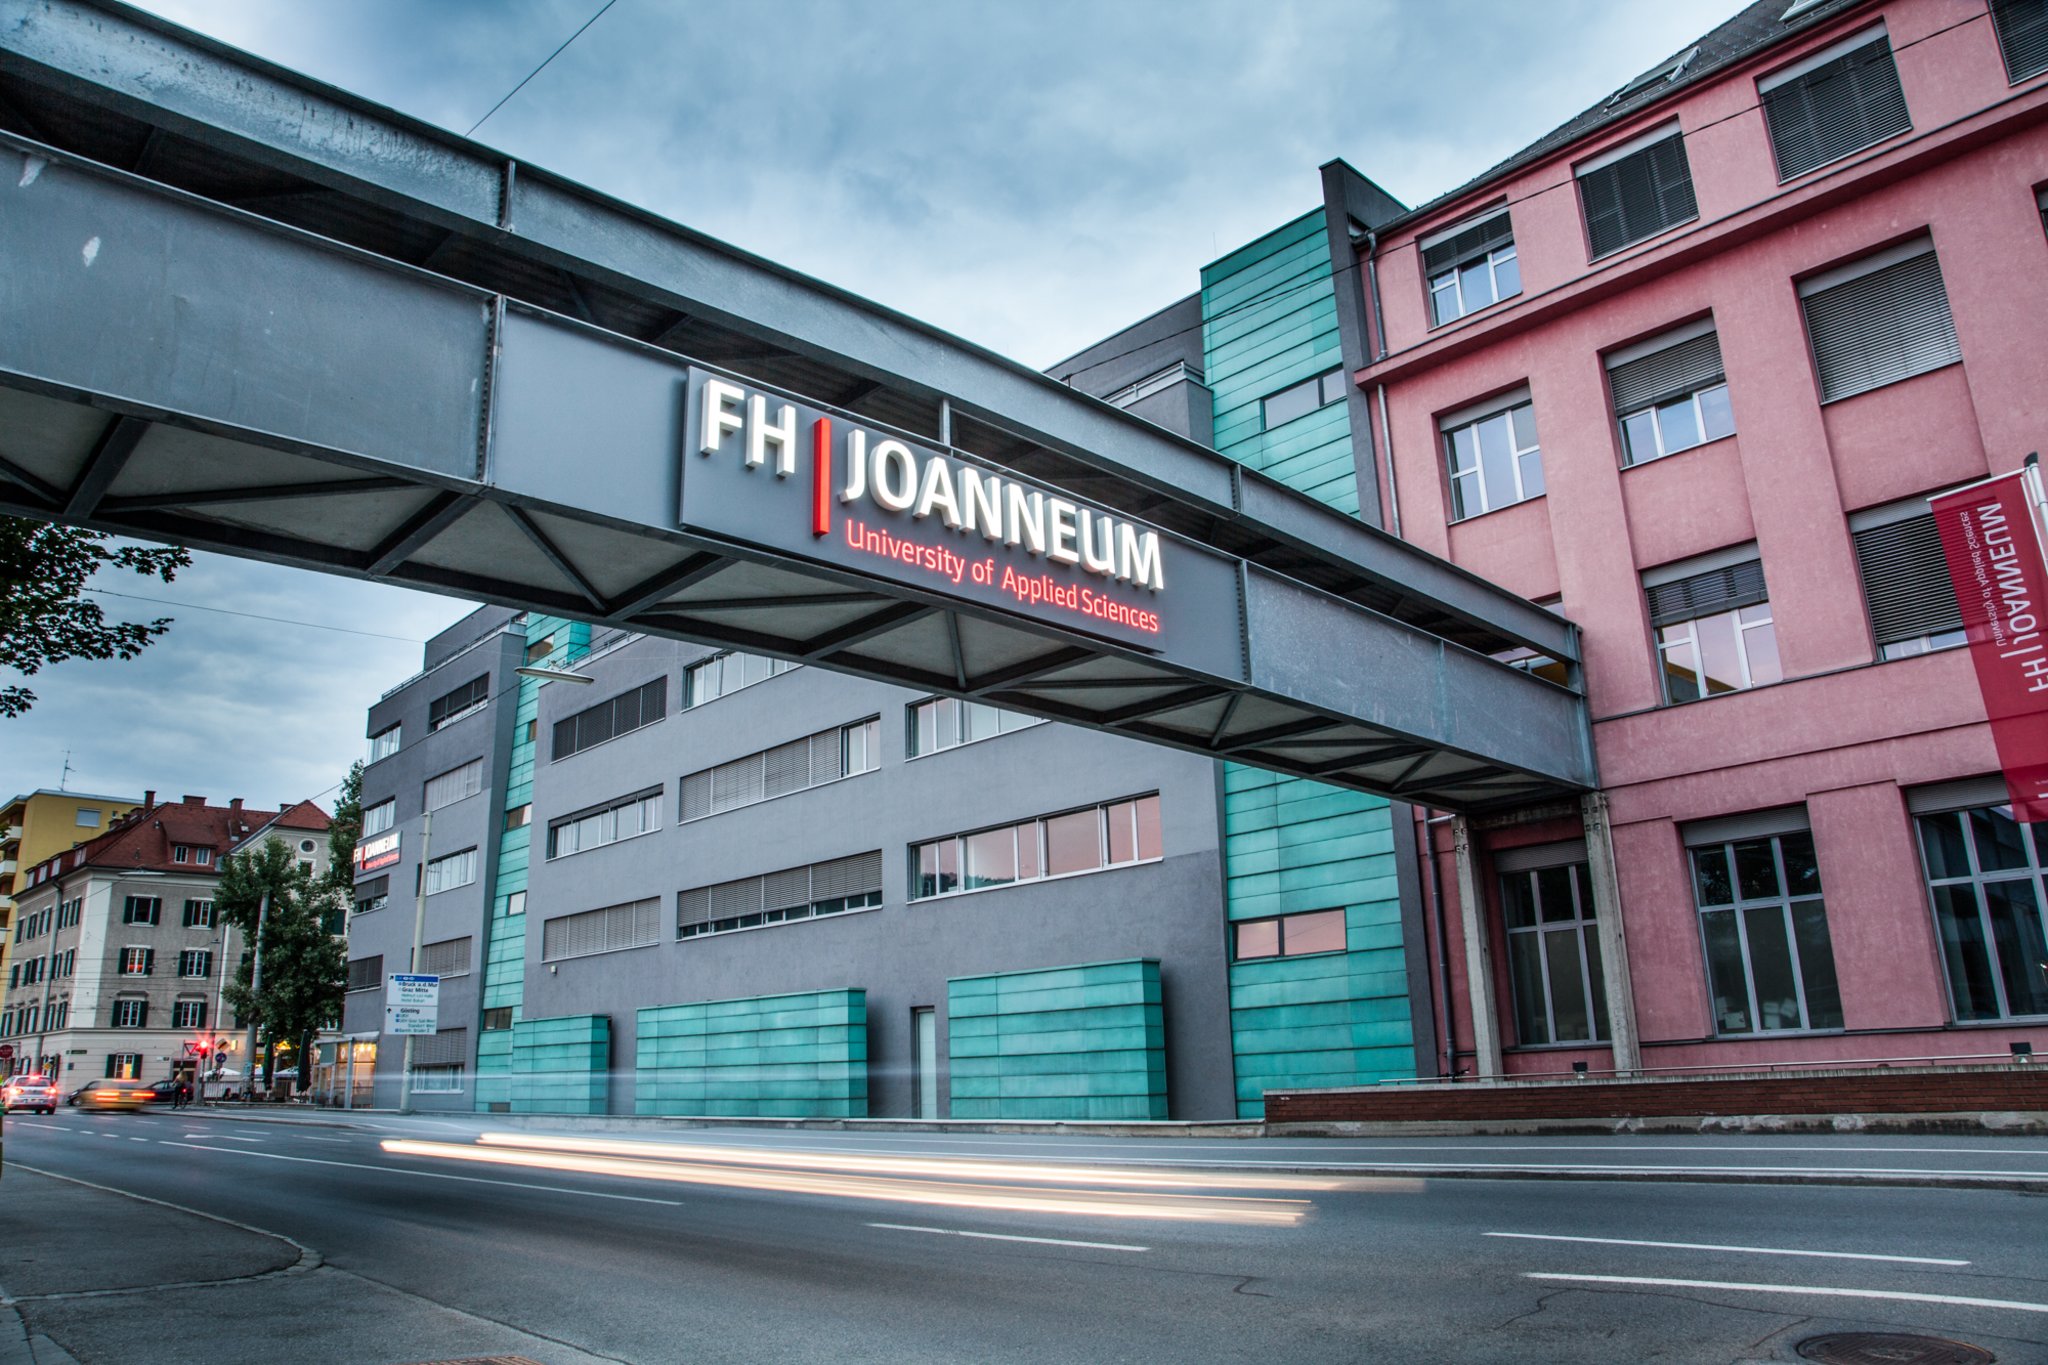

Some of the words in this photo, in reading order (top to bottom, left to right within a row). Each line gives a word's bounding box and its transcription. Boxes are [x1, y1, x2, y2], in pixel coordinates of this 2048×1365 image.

[701, 379, 796, 478] FH
[840, 428, 1165, 592] JOANNEUM
[847, 518, 965, 584] University
[972, 558, 995, 586] of
[1002, 566, 1078, 605] Applied
[1081, 588, 1159, 633] Sciences
